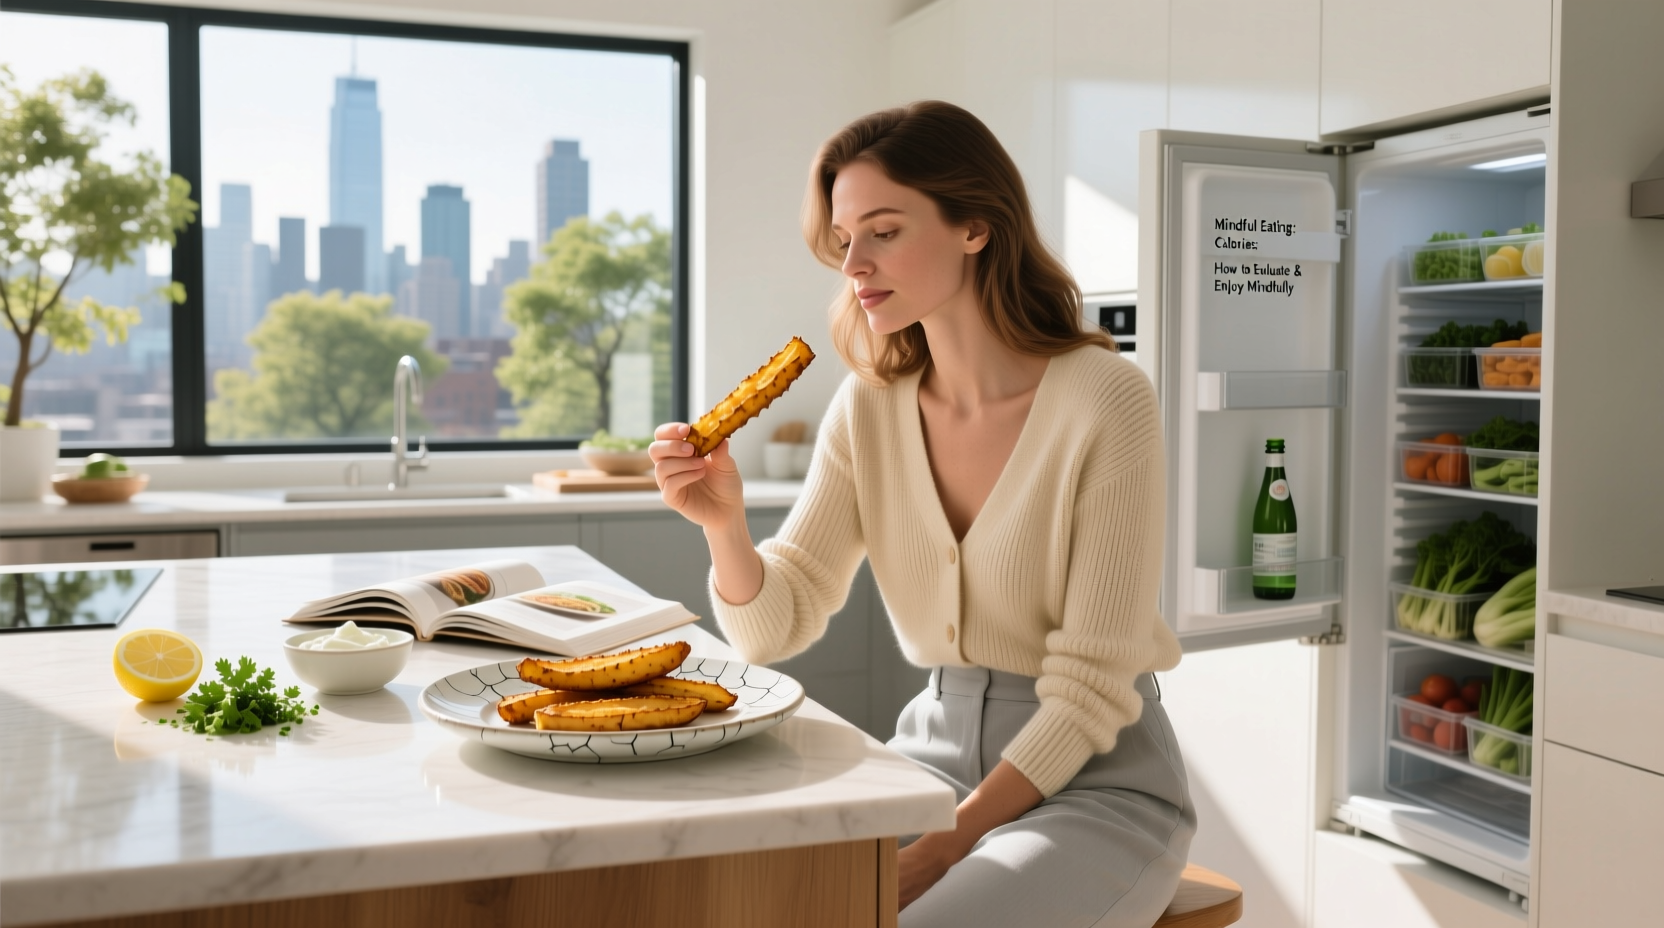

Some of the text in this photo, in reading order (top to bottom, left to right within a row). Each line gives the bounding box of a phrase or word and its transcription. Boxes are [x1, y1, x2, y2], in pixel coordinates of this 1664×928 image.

[1215, 218, 1257, 232] Mindful
[1214, 261, 1237, 275] How
[1241, 263, 1251, 274] to
[1293, 264, 1302, 276] &
